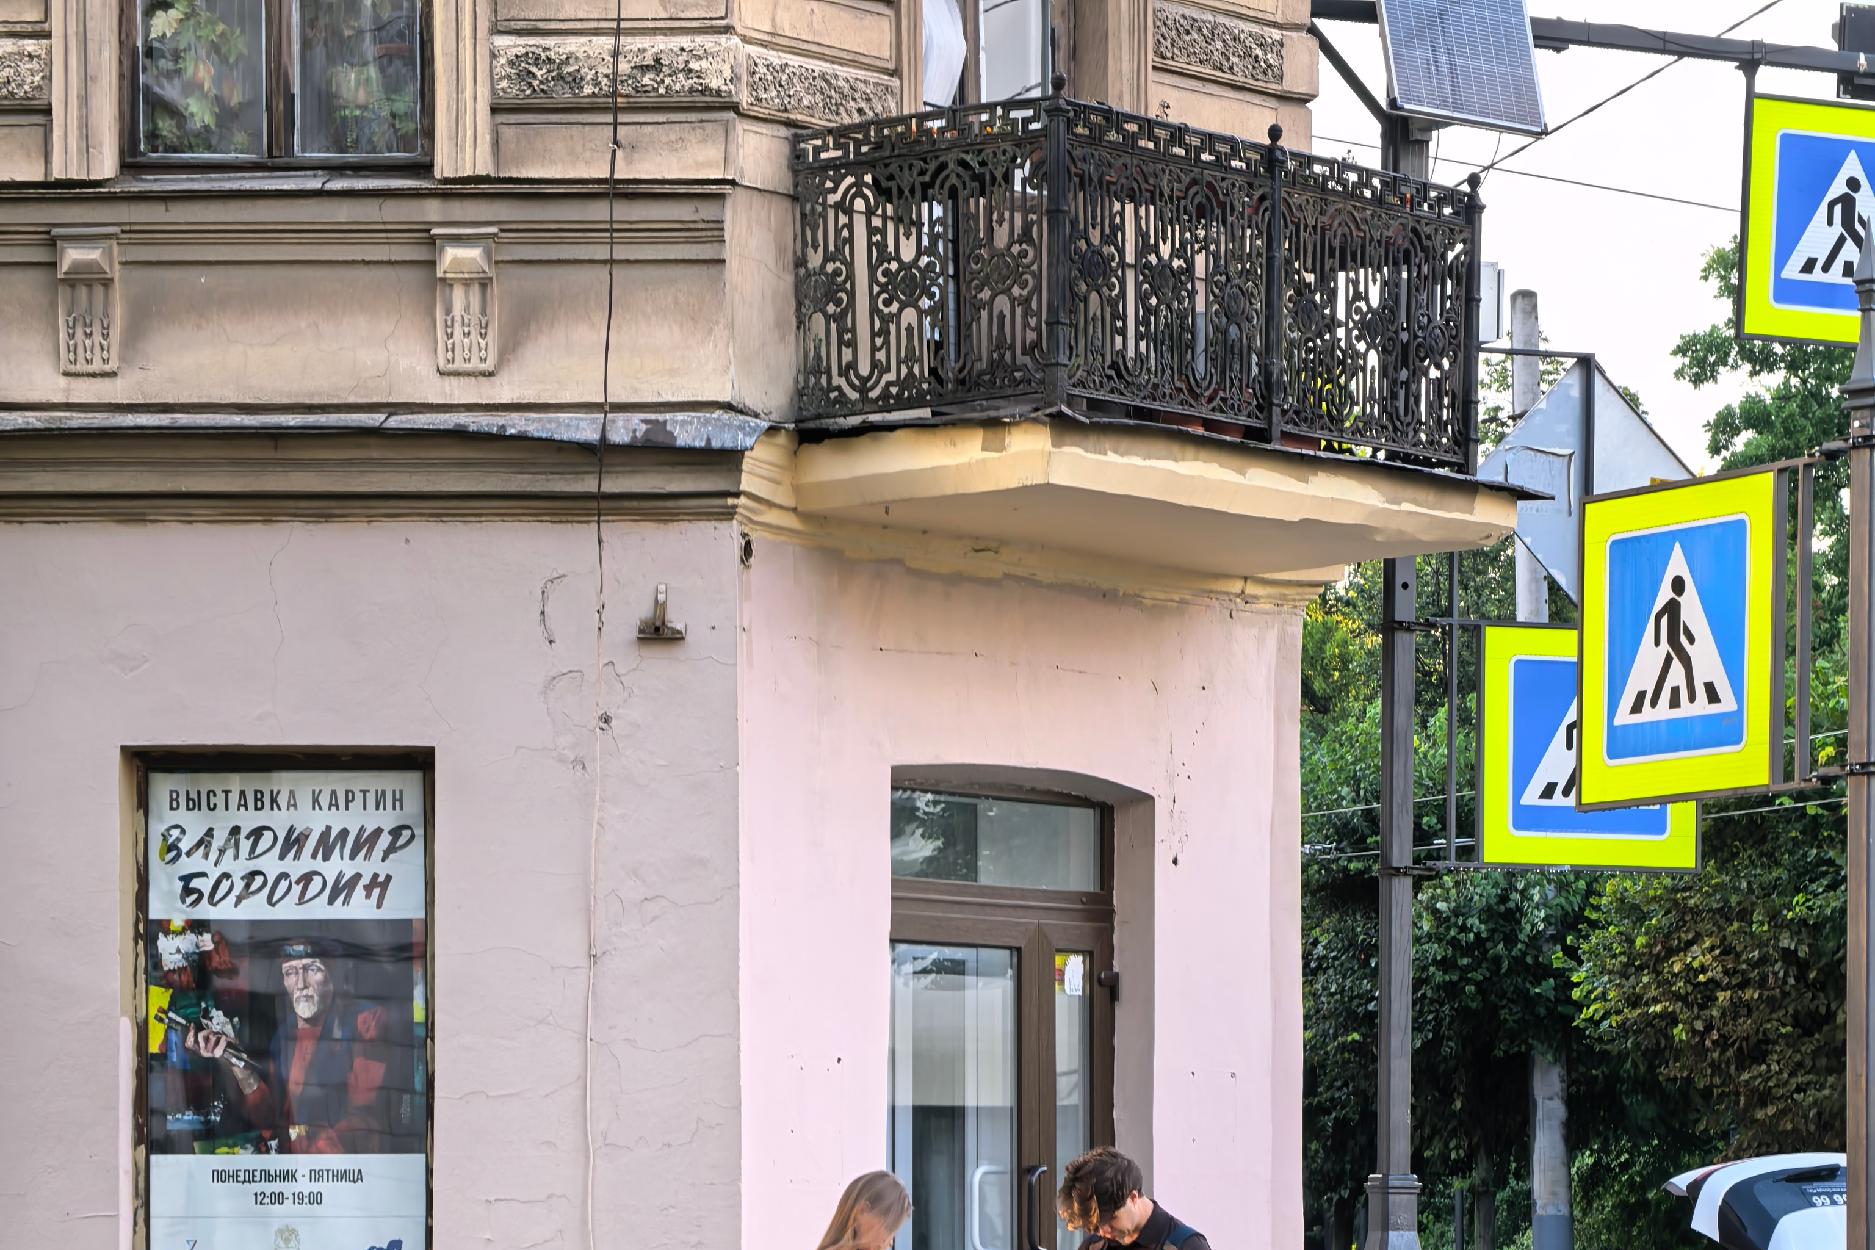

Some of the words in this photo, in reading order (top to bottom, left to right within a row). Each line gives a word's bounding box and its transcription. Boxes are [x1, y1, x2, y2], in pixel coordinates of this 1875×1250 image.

[168, 789, 299, 812] ВЫСТАВКА
[311, 789, 405, 812] КАРТИН
[158, 823, 417, 868] ВЛАДИМИР
[177, 869, 393, 910] БОРОДИН
[211, 1168, 298, 1185] ПОНЕДЕЛЬНИК
[308, 1168, 364, 1184] ПЯТНИЦА
[253, 1191, 323, 1206] 12:00-19:00
